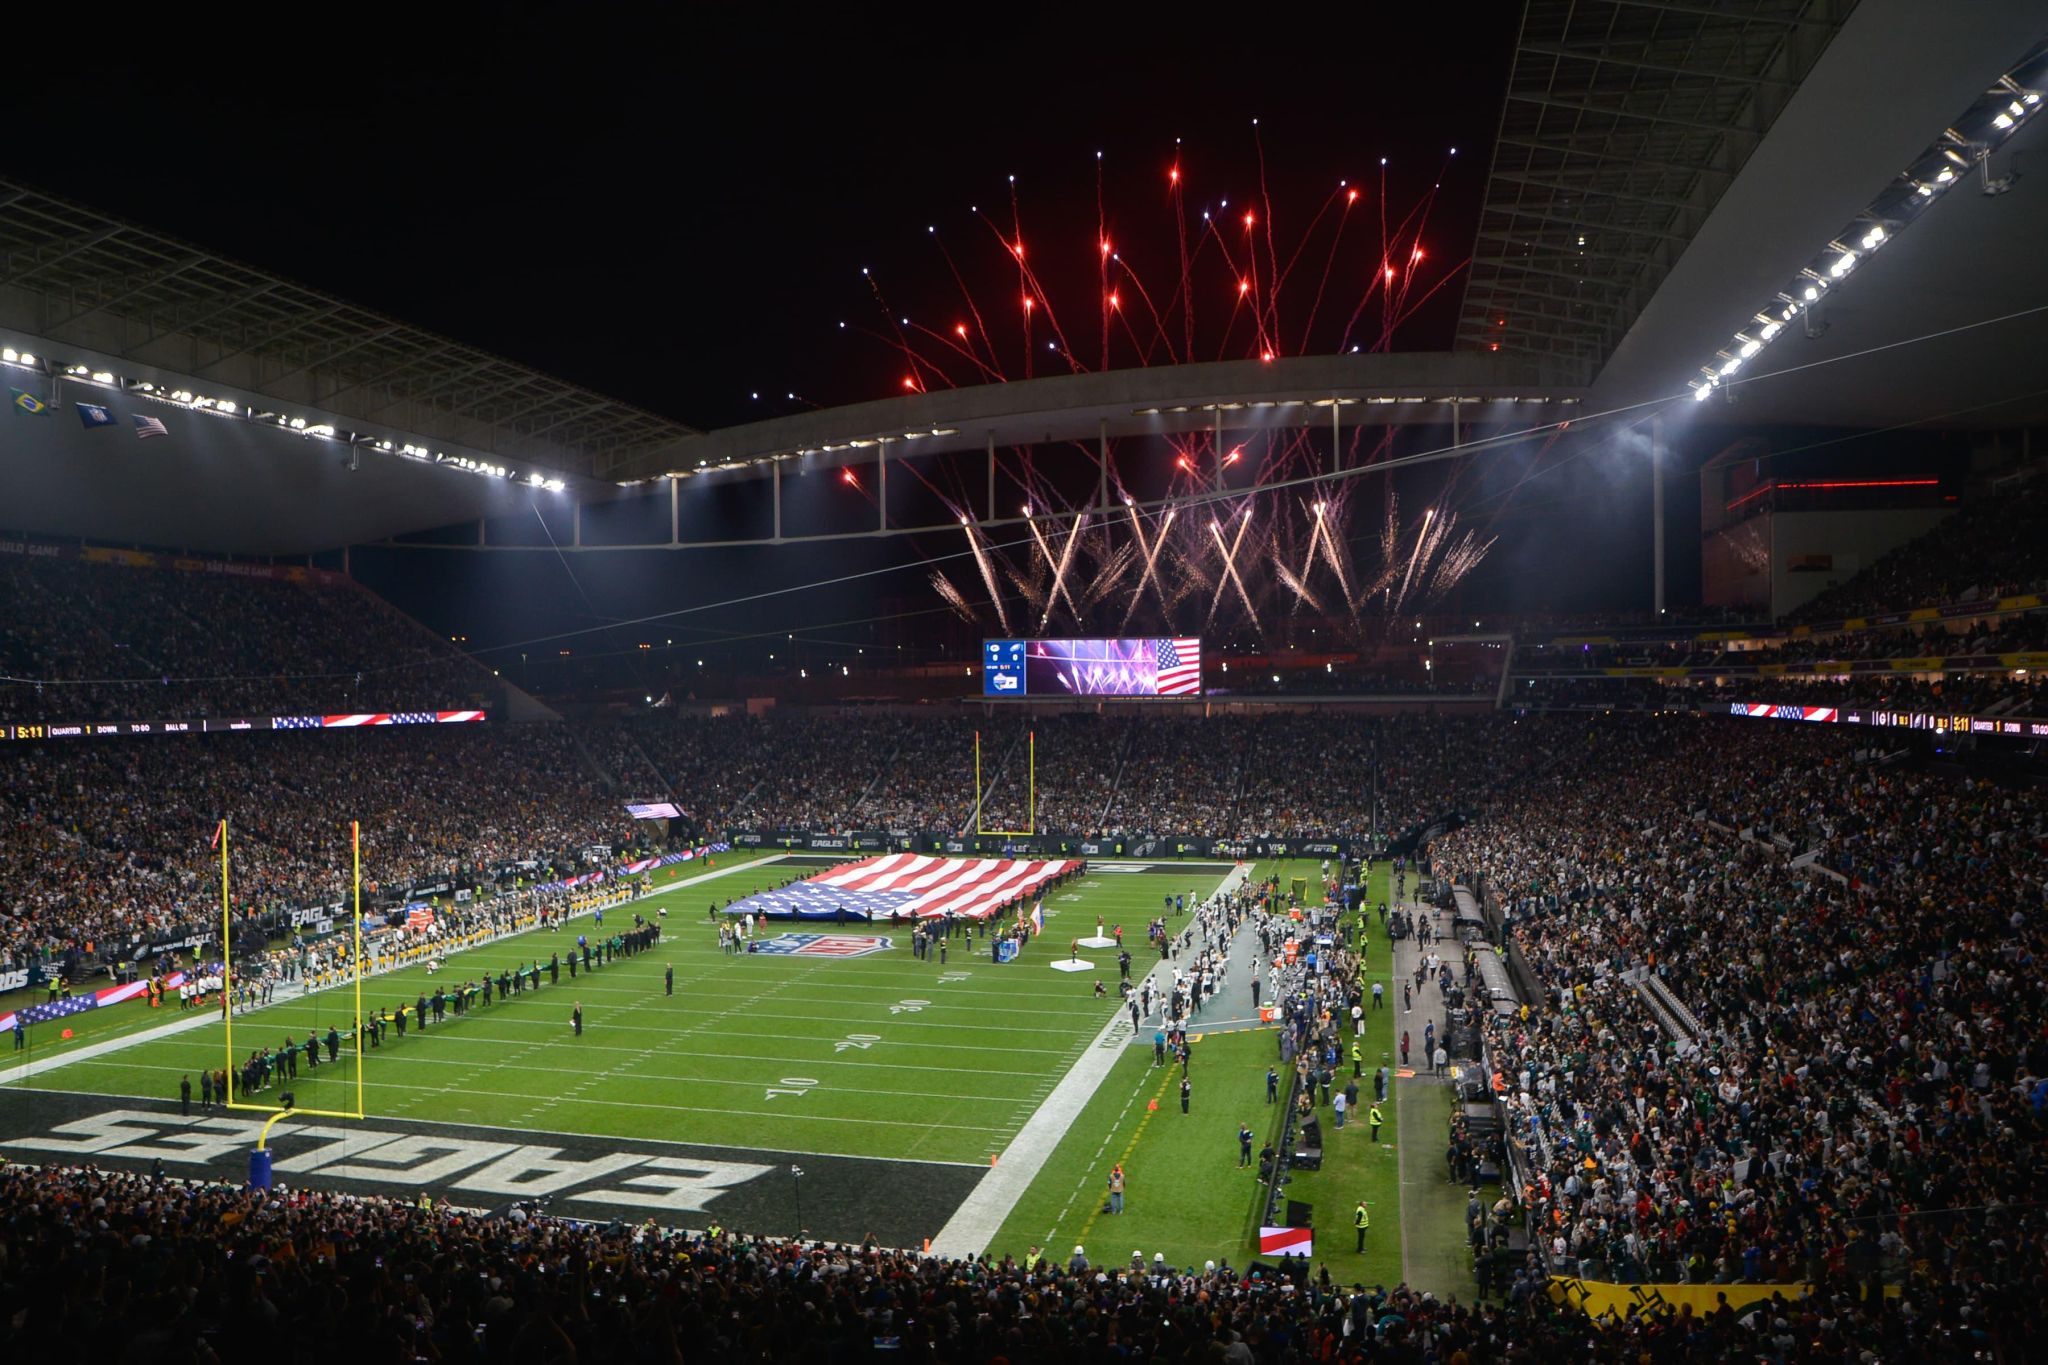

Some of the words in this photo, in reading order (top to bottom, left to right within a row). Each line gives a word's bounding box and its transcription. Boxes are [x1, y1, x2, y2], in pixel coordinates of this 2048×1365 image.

[0, 540, 24, 554] ULO
[28, 544, 60, 557] GAME
[17, 726, 43, 739] 5:11
[52, 726, 82, 736] QUARTER
[85, 725, 91, 734] 1
[97, 725, 118, 734] DOWN
[131, 724, 140, 732] TO
[165, 723, 179, 731] BALL
[1953, 716, 1969, 732] 5:11
[1973, 720, 1994, 731] QUARTER
[2004, 722, 2021, 733] DOWN
[811, 839, 844, 848] EAGLES
[1097, 1020, 1134, 1050] KICKOFF
[765, 1077, 819, 1098] 10
[0, 1109, 777, 1213] EAGLES
